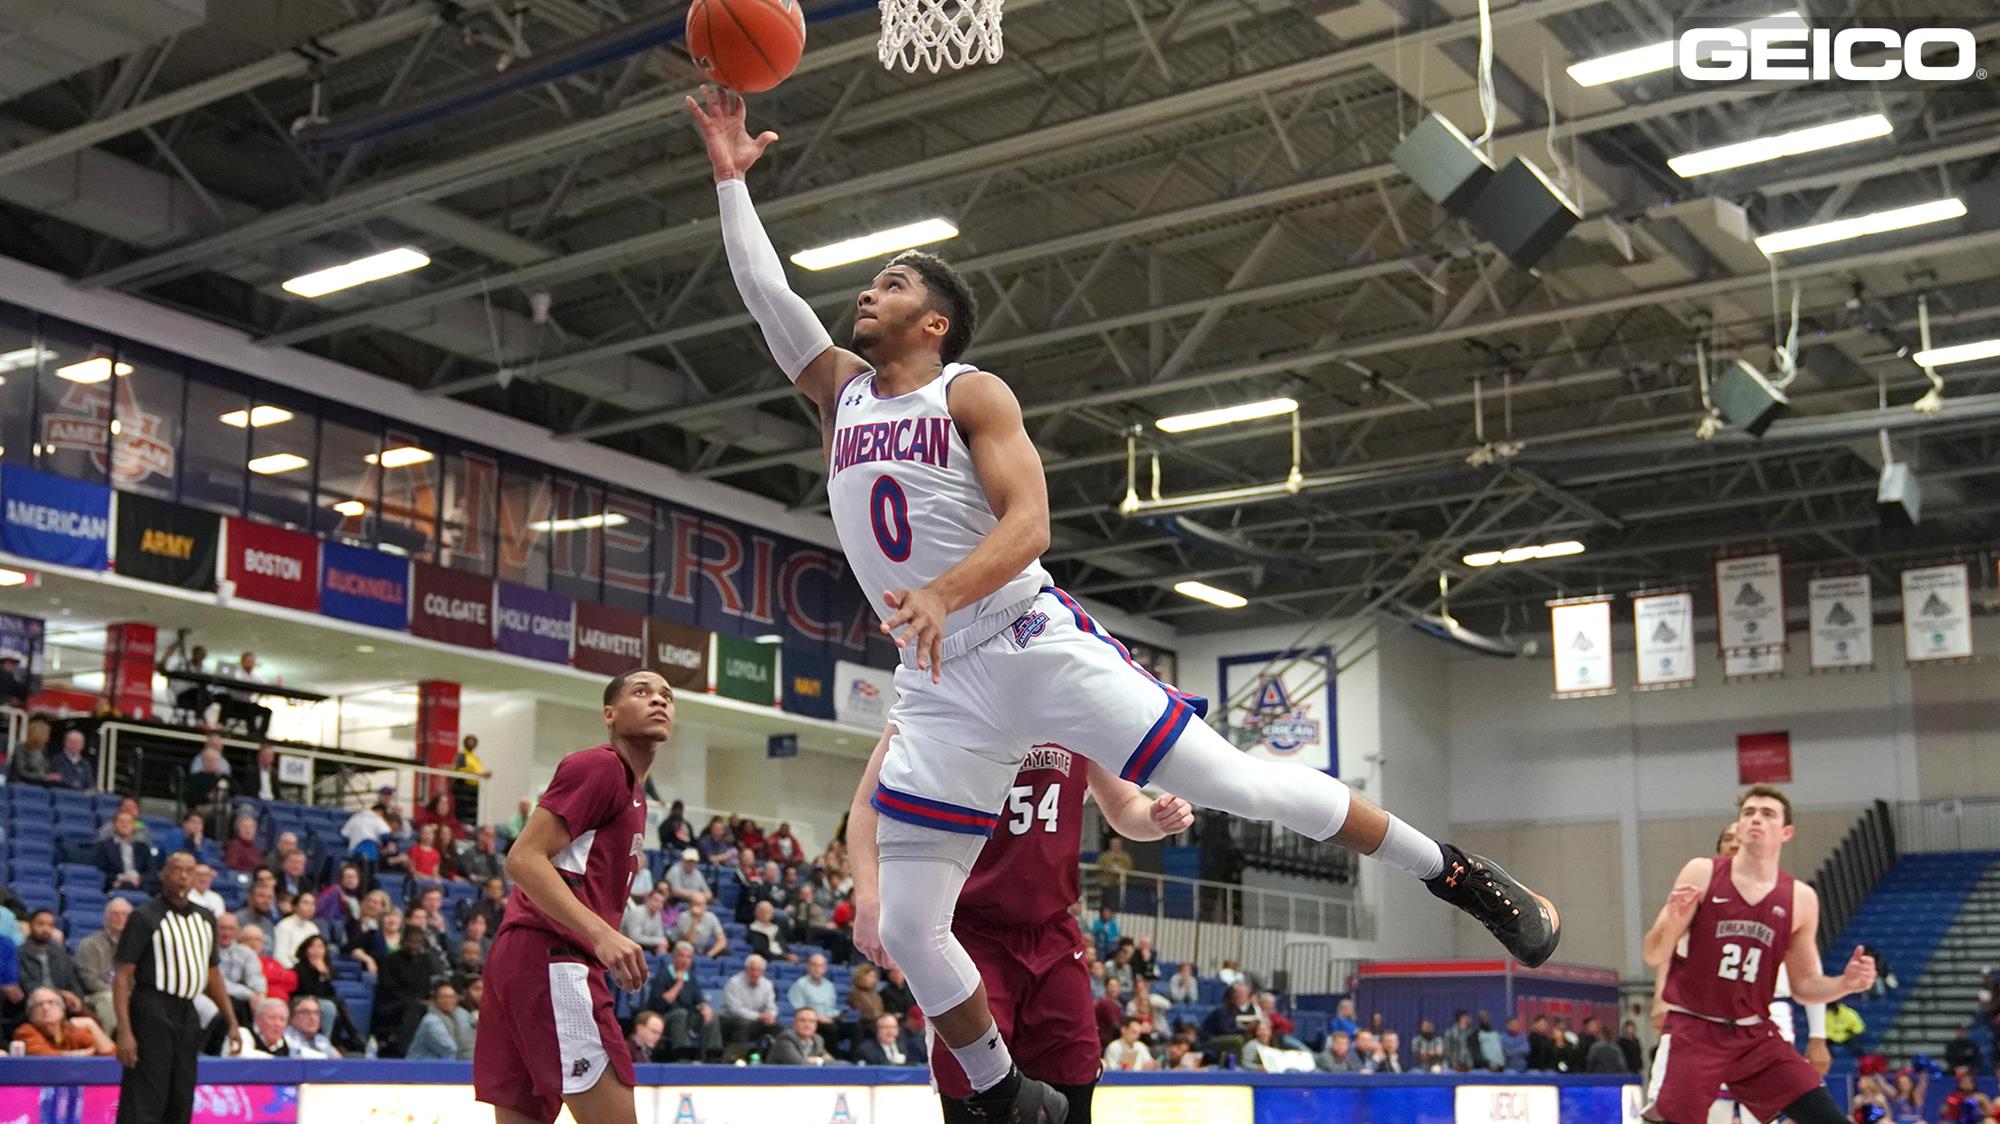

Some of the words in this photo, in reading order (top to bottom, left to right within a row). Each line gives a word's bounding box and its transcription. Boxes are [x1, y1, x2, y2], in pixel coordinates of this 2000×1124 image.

[833, 417, 952, 480] AMERICAN
[6, 499, 106, 540] AMERICAN
[870, 474, 912, 562] 0
[141, 529, 193, 560] ARMY
[244, 548, 302, 581] BOSTON
[327, 568, 404, 604] BUCKNELL
[424, 593, 487, 625] COLGATE
[499, 607, 530, 632] HOLY
[578, 626, 642, 659] LAFAYETTE
[658, 642, 701, 669] LEHIGH
[726, 657, 767, 682] LOYOLA
[1020, 750, 1071, 772] AYETTE
[1009, 783, 1060, 835] 54
[1717, 943, 1762, 983] 24
